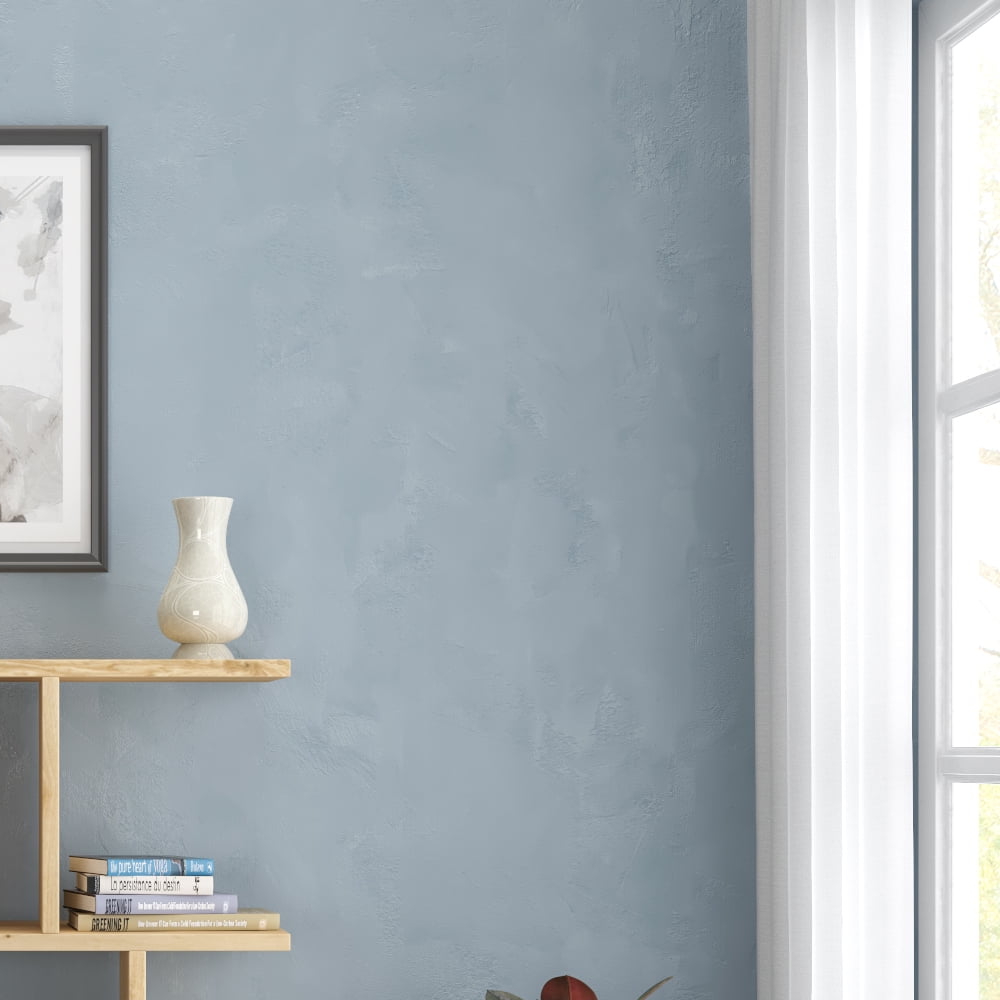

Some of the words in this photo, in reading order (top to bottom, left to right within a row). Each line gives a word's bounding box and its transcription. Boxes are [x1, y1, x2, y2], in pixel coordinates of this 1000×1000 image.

[111, 876, 118, 891] La
[91, 917, 122, 932] GREENING
[122, 917, 130, 932] IT
